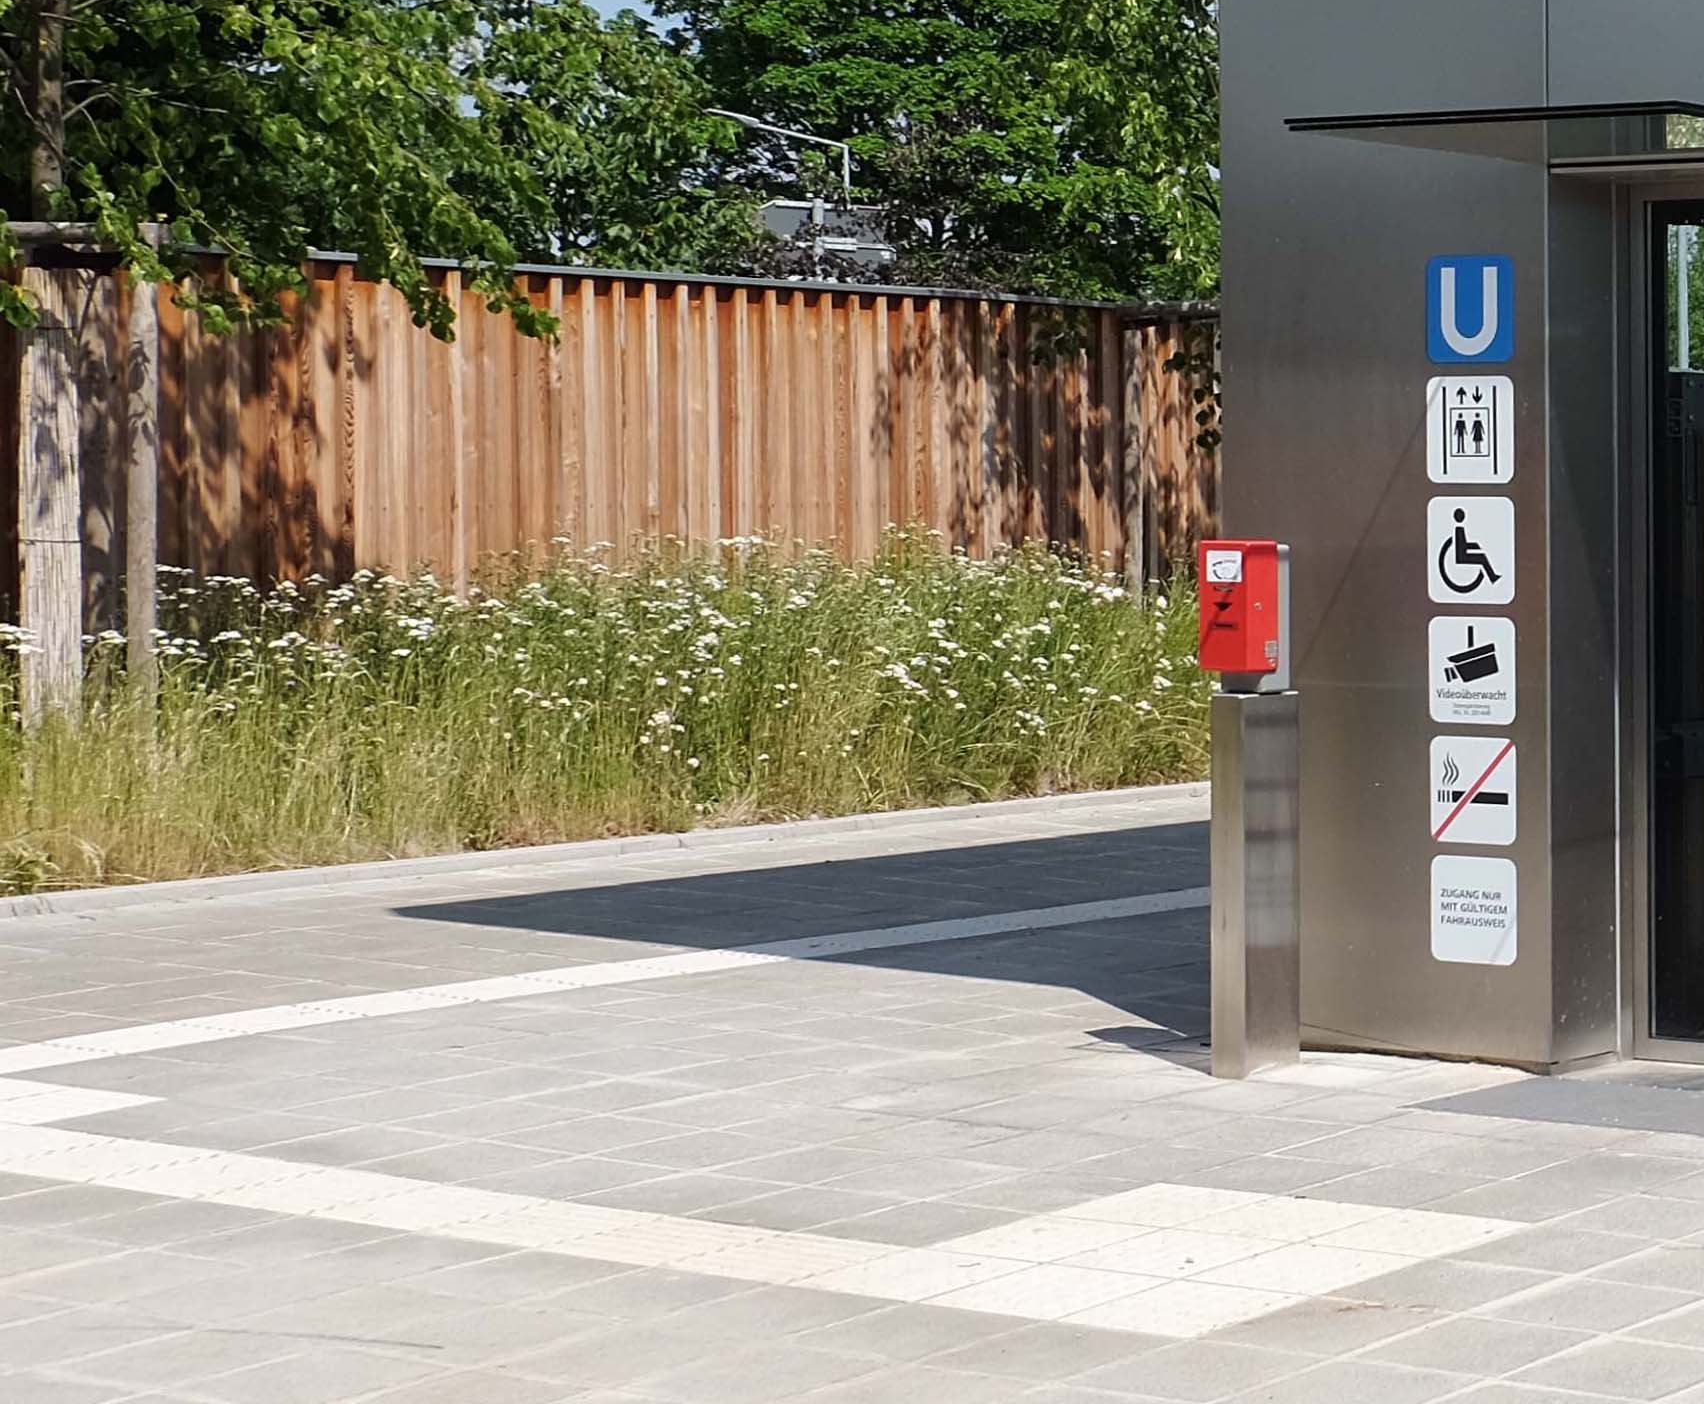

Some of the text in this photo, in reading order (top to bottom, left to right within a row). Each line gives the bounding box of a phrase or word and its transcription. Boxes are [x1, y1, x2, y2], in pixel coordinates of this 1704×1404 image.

[1440, 266, 1498, 356] U
[1436, 688, 1507, 700] Videoüberwacht
[1440, 888, 1501, 900] ZUGANG NUR
[1440, 901, 1507, 914] MIT GÜLTIGEM
[1440, 915, 1506, 928] FAHRAUSWEIS
